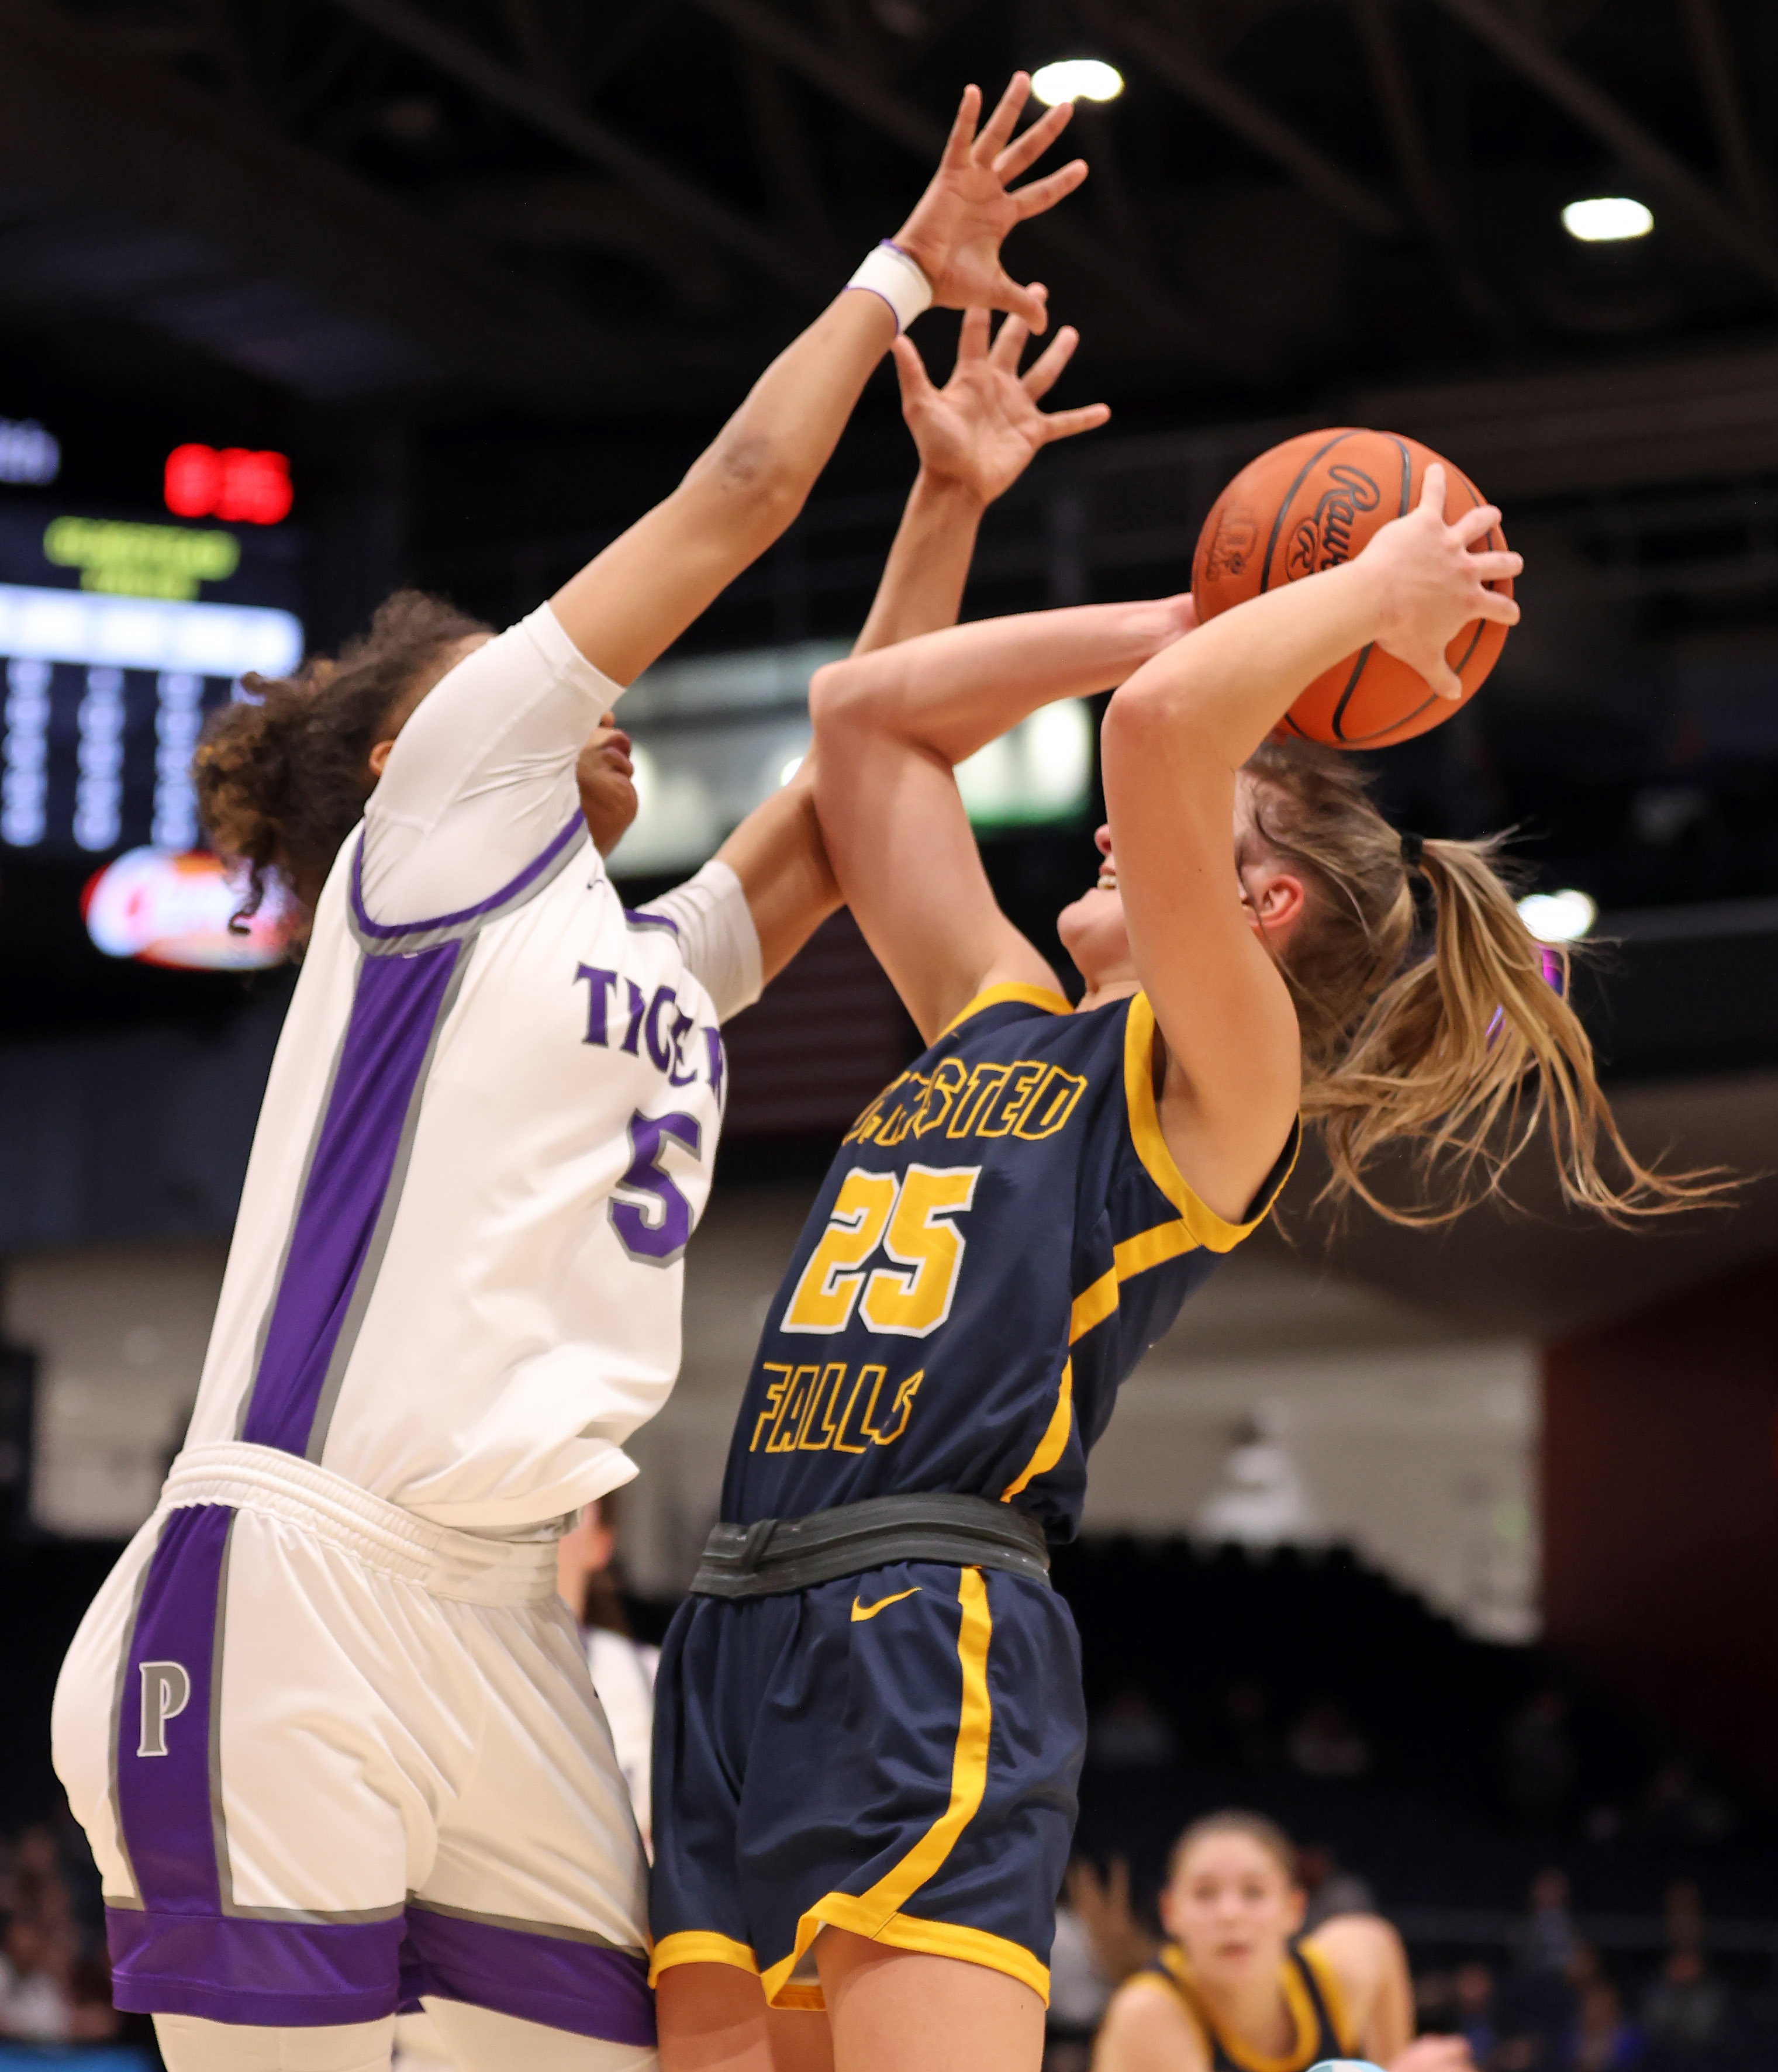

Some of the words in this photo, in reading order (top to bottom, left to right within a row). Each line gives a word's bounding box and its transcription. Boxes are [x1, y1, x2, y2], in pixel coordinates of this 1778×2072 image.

[607, 1107, 701, 1269] 5
[779, 1163, 983, 1339] 25
[137, 1661, 191, 1757] P
